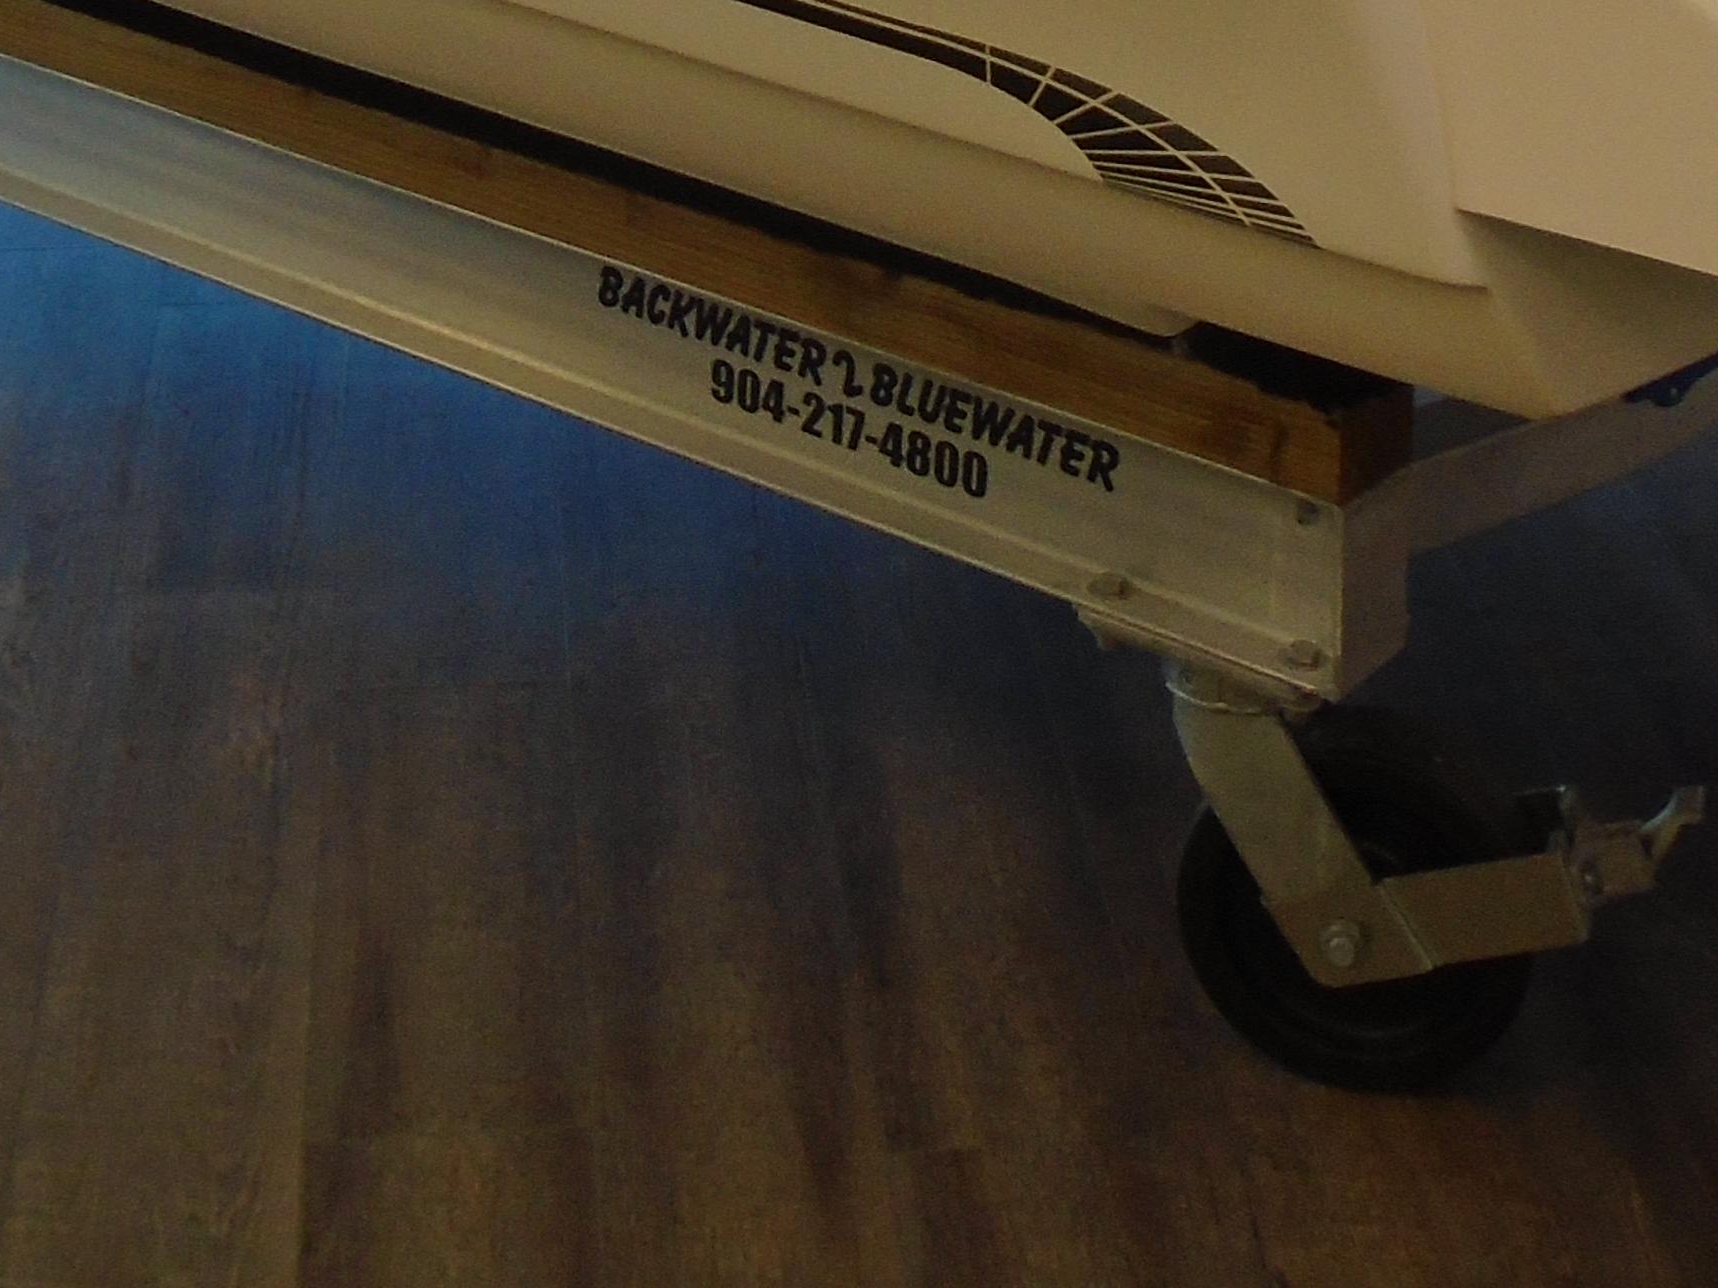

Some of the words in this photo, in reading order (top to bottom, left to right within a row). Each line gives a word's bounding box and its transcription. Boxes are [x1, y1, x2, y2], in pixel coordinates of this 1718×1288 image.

[598, 265, 827, 387] BACKWATER
[832, 351, 864, 398] 2
[869, 363, 1120, 492] BLUEWATER
[710, 358, 989, 498] 904-217-4800
